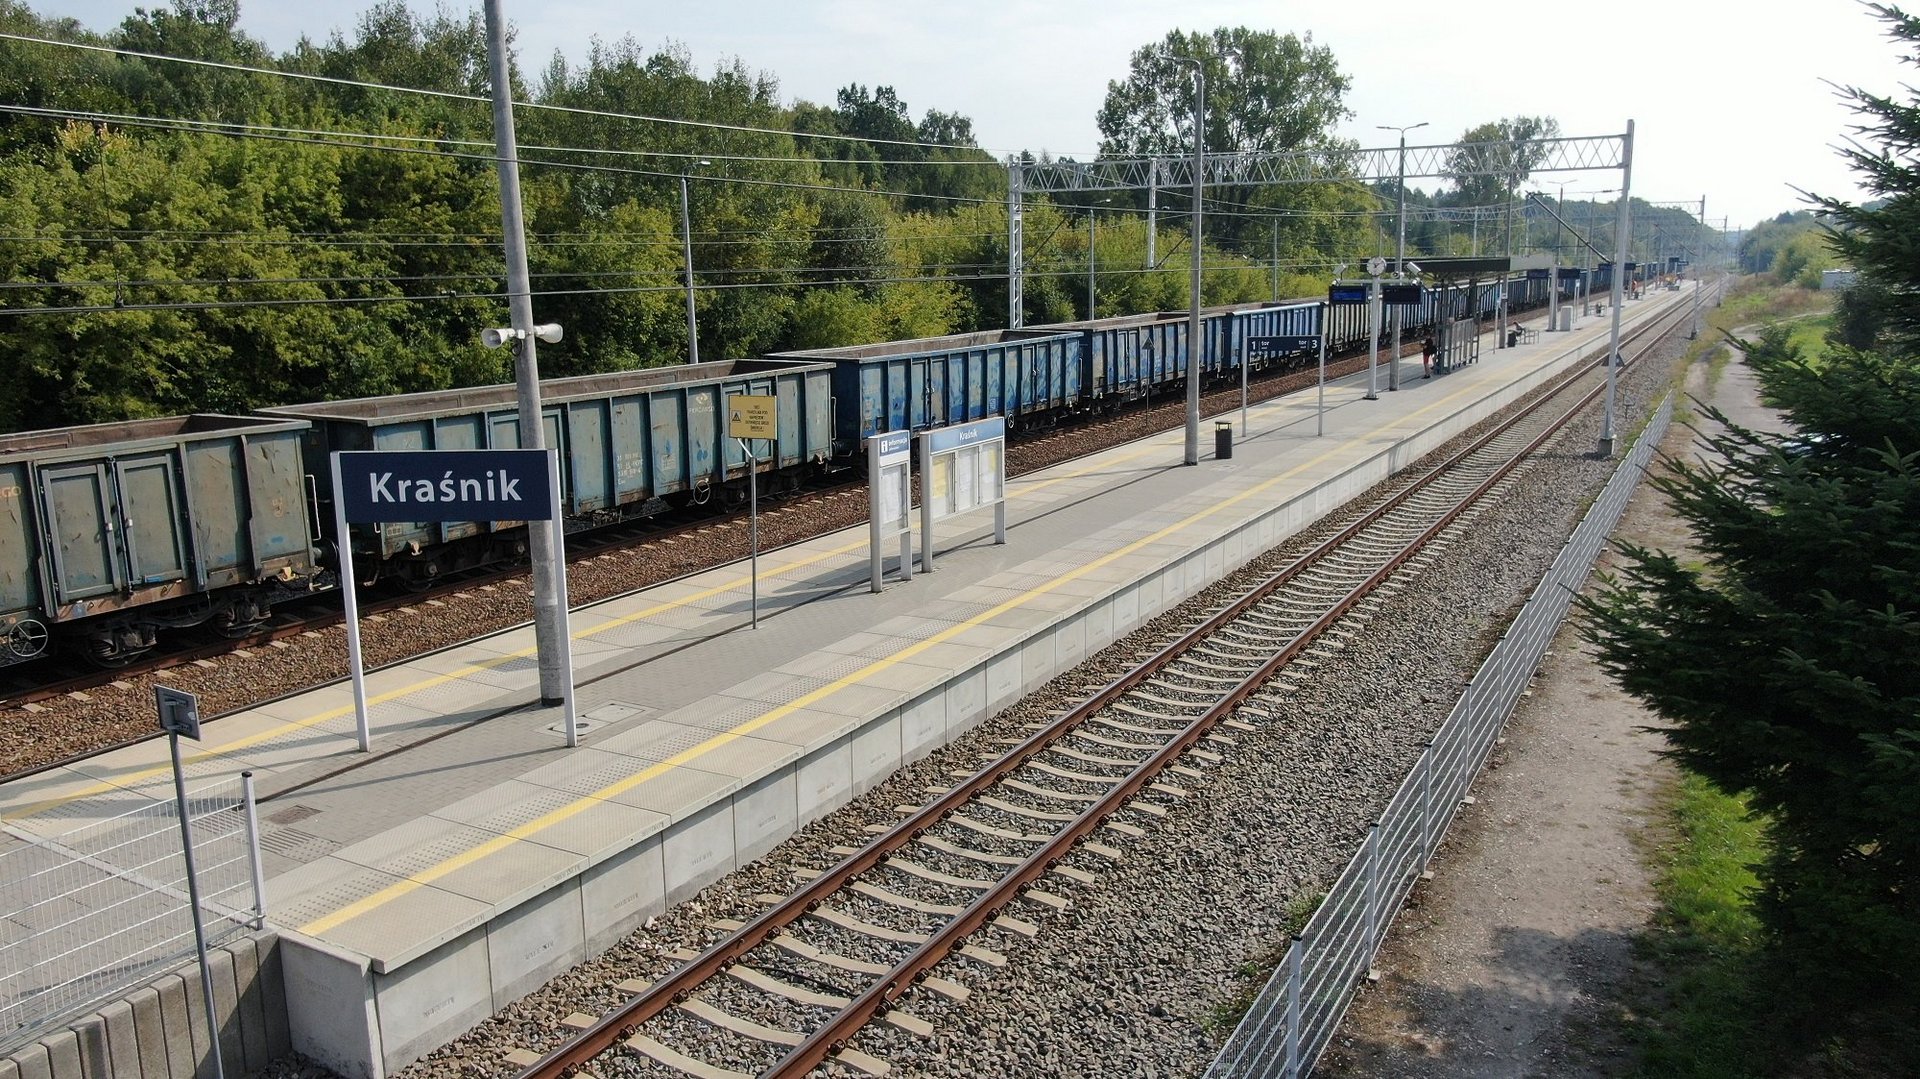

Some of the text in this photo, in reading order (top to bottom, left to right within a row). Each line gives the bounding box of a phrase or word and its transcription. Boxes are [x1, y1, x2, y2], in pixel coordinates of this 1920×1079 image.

[1252, 341, 1256, 350] 1
[1312, 340, 1318, 348] 3
[369, 469, 522, 503] Kraśnik
